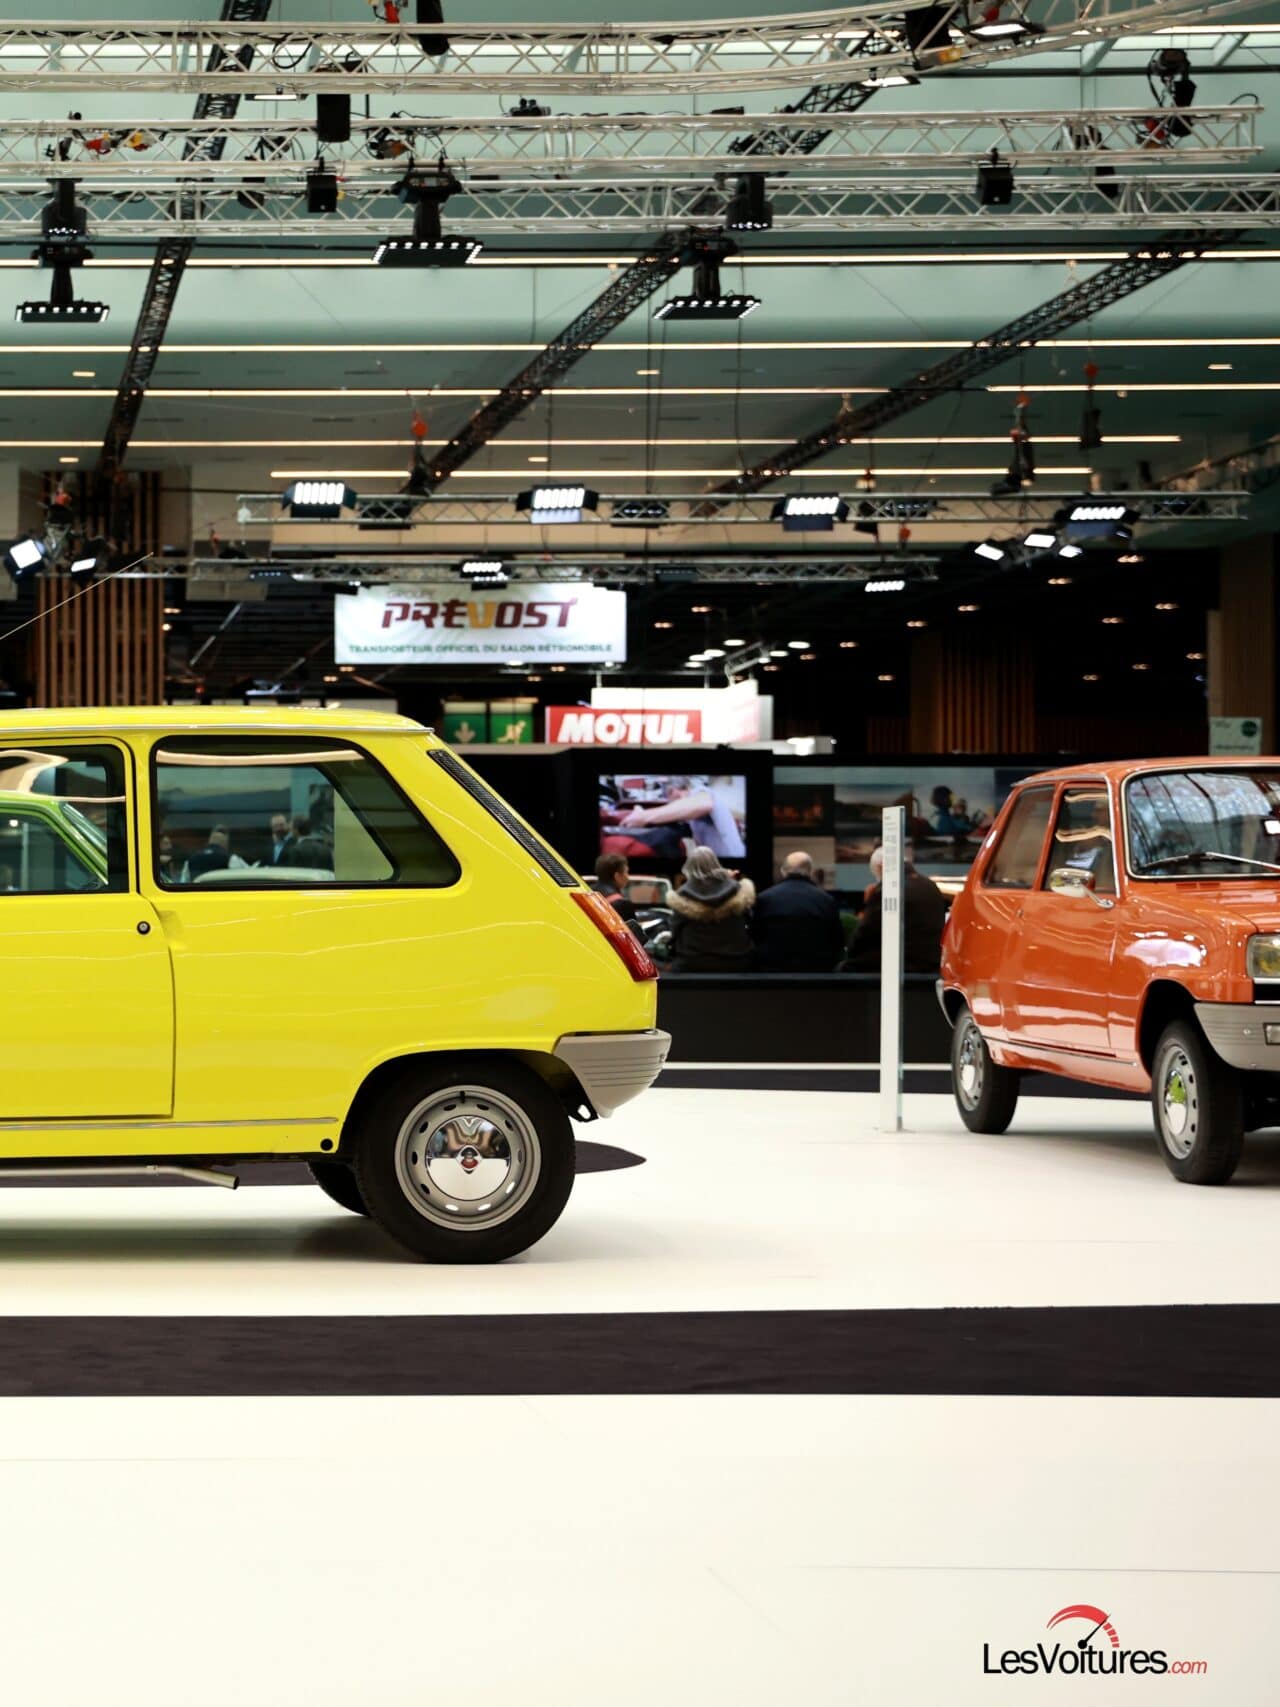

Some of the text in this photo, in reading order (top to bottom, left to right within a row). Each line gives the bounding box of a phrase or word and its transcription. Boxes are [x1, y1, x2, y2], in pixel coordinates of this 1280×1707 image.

[349, 644, 433, 653] TRANSPORTEUR
[435, 644, 480, 653] OFFICIEL
[482, 644, 498, 653] DU
[500, 644, 535, 653] SALON
[556, 712, 695, 743] MOTUL
